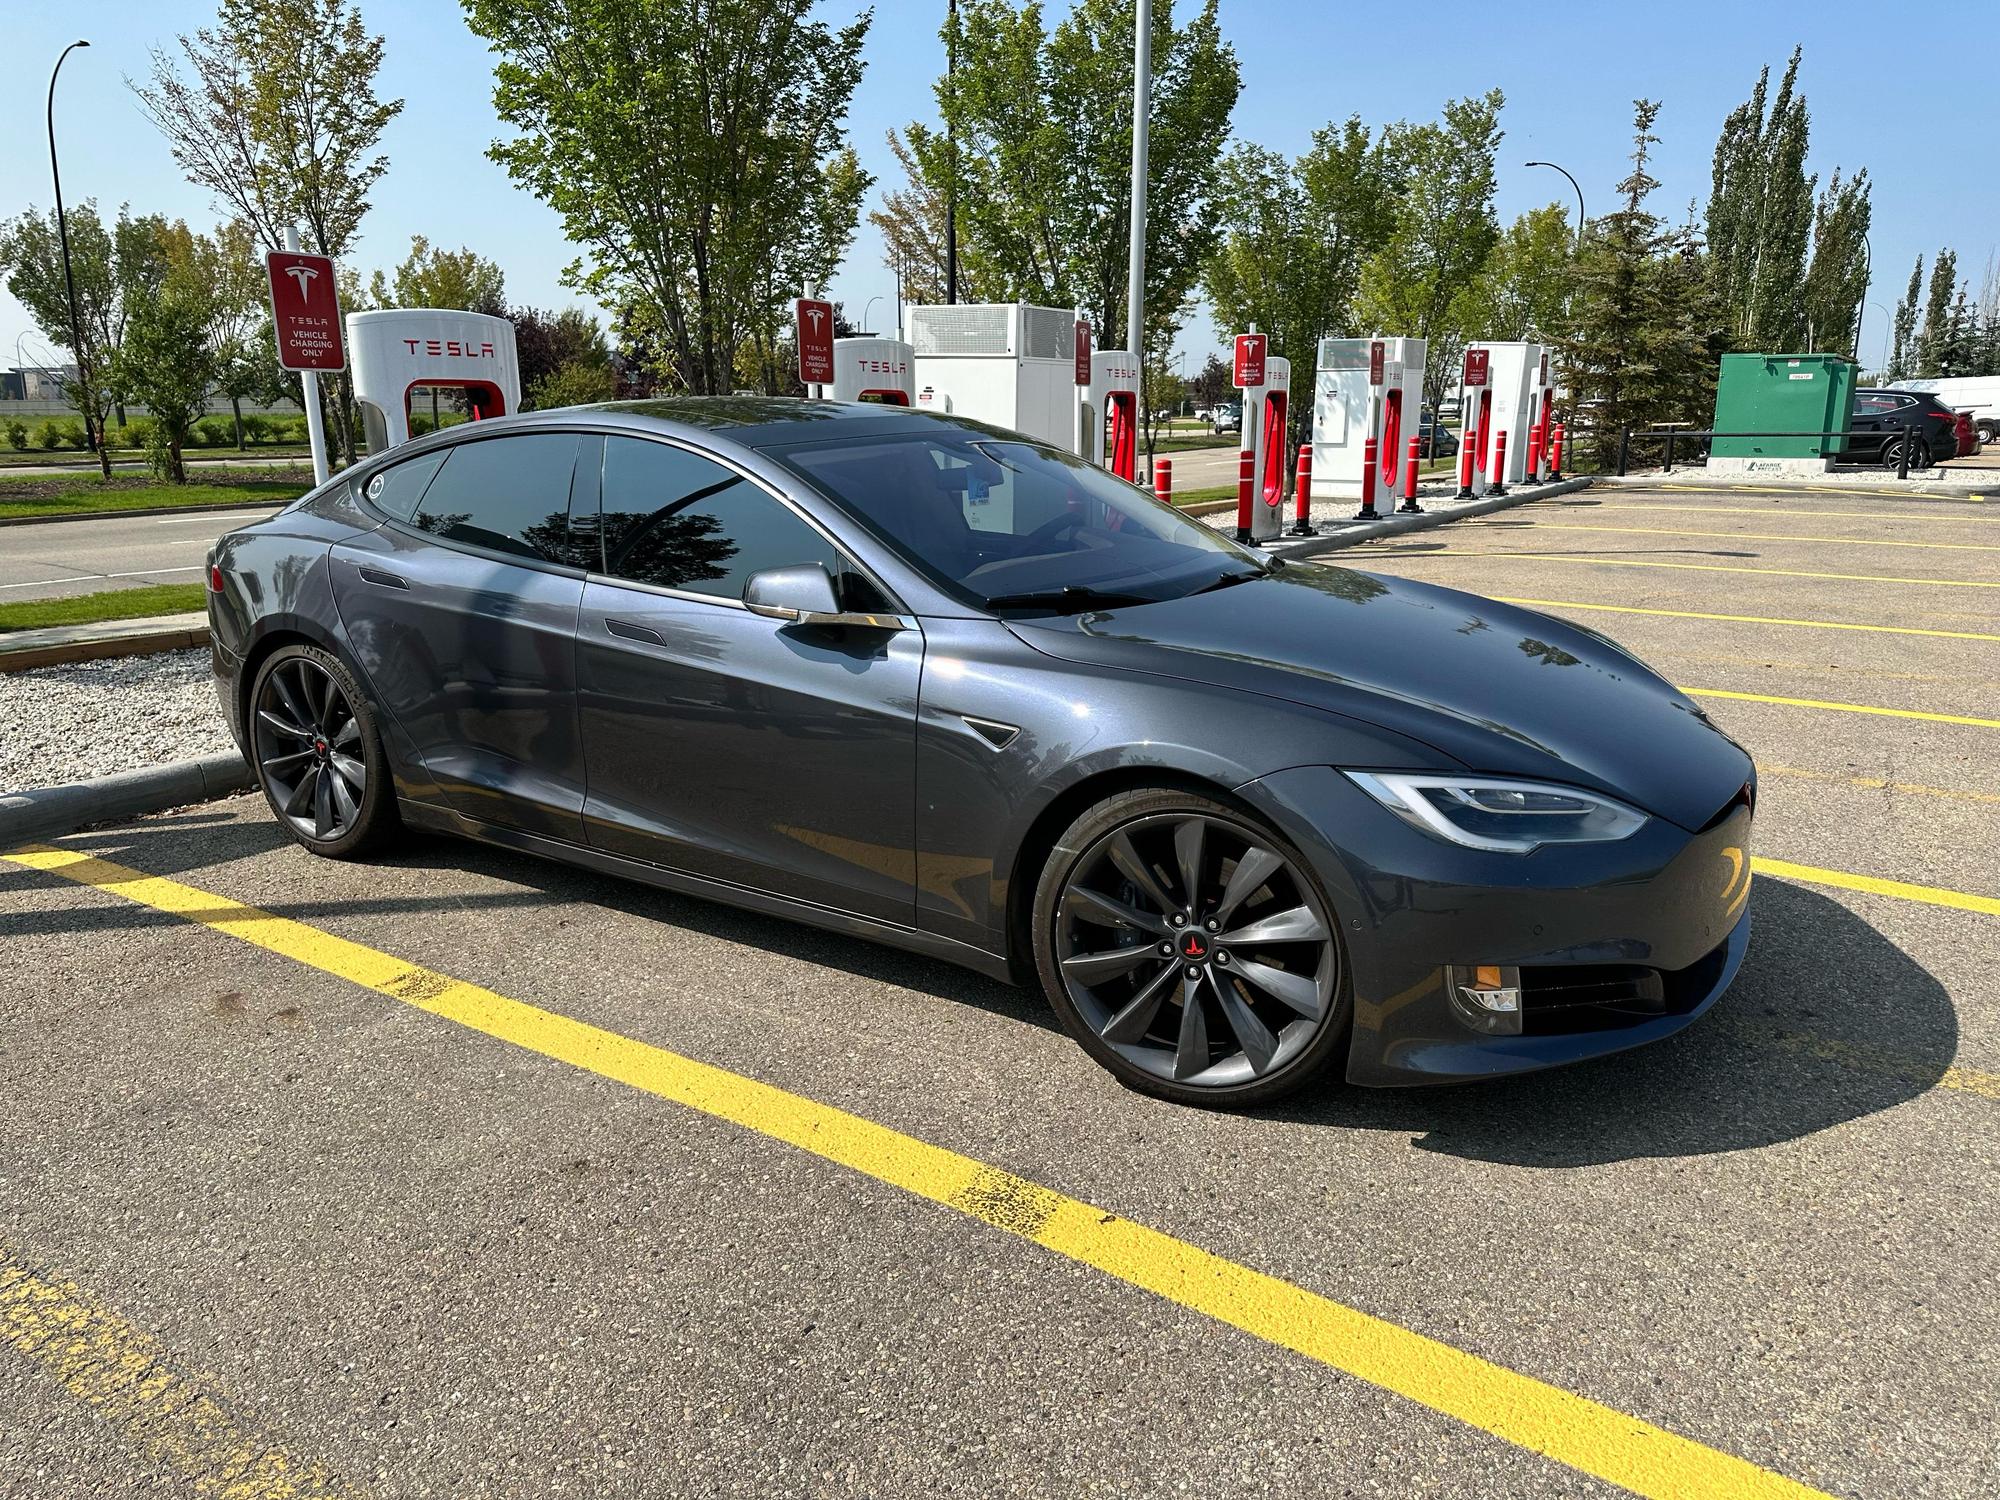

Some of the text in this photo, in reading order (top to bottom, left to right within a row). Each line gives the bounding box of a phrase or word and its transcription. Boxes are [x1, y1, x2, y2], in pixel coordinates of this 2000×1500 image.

[289, 316, 328, 326] TESLA
[293, 330, 328, 340] VEHICLE
[290, 339, 333, 349] CHARGING
[403, 339, 494, 358] TESLA
[806, 344, 828, 352] TESLA
[302, 348, 324, 357] ONLY
[807, 354, 826, 362] VEHICLE
[805, 361, 829, 369] CHARGING
[858, 360, 906, 374] TESLA
[811, 367, 824, 375] ONLY
[1106, 368, 1136, 379] TESLA
[321, 654, 353, 693] MICHELIN
